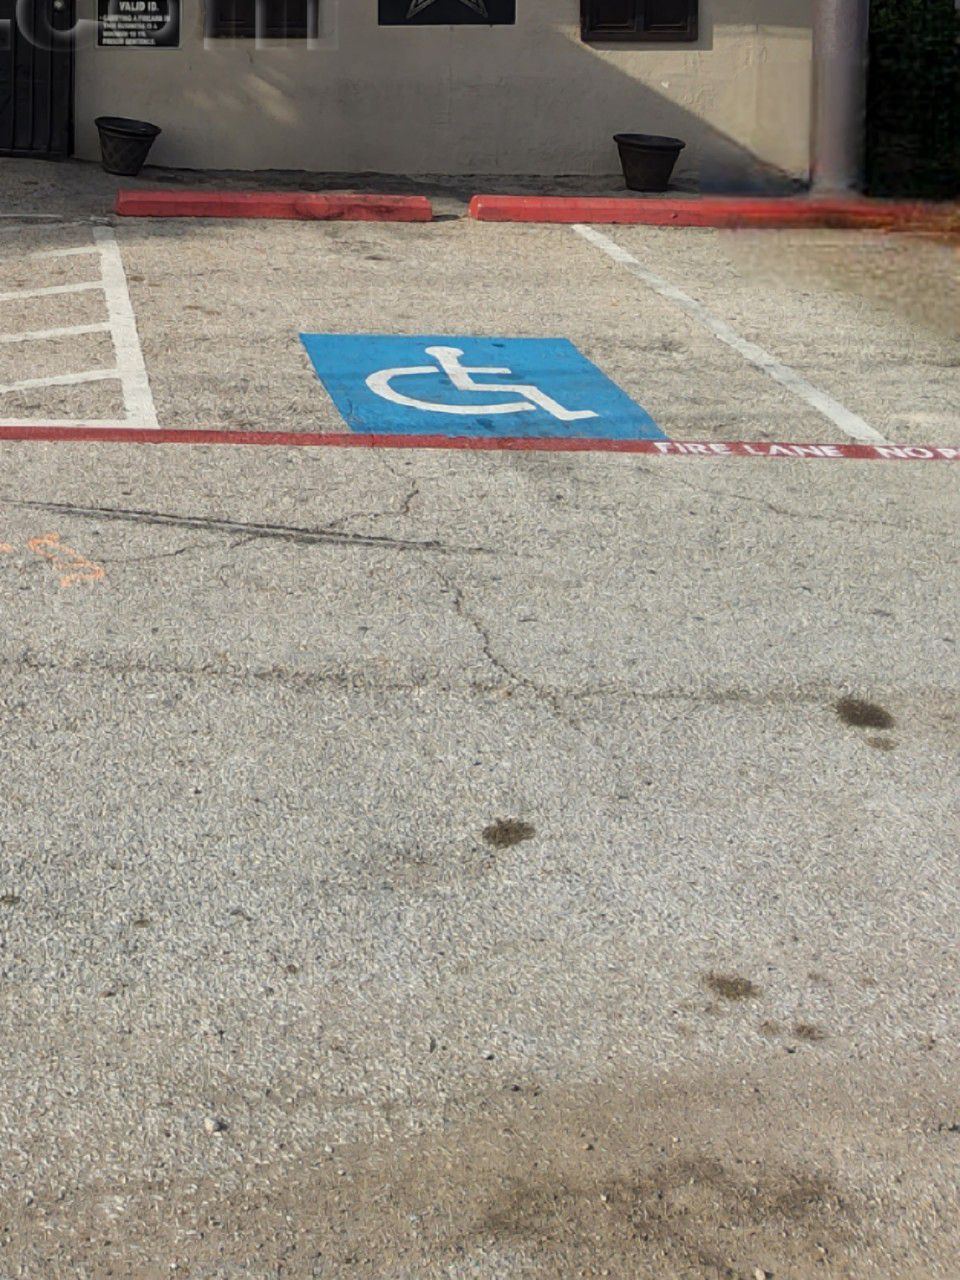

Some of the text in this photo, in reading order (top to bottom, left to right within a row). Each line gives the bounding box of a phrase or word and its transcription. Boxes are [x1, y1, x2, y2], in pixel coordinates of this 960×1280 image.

[119, 1, 146, 11] VALID
[653, 442, 732, 455] FIRE
[743, 443, 844, 458] LANE
[874, 446, 934, 458] NO
